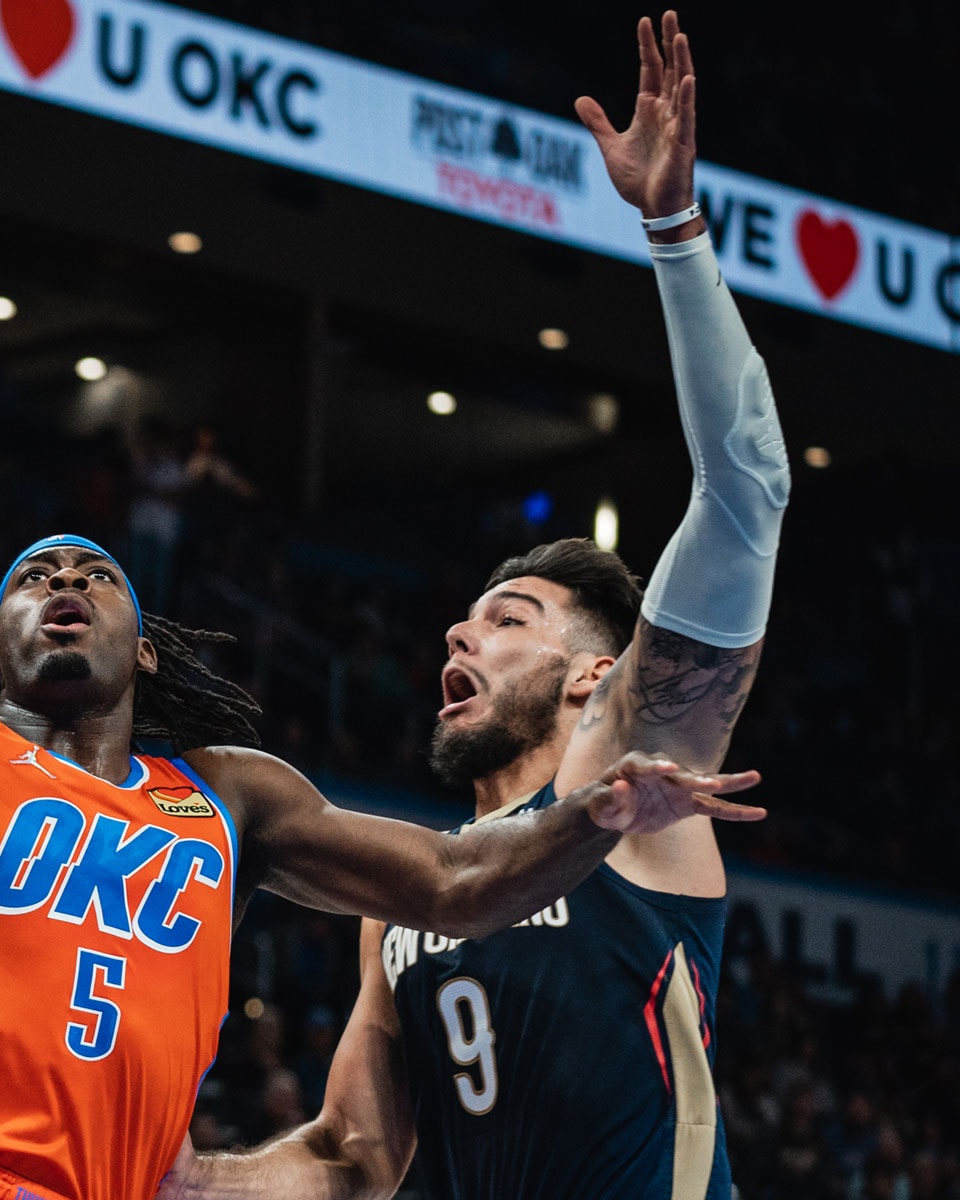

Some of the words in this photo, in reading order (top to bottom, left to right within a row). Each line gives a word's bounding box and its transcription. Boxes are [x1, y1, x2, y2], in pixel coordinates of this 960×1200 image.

[96, 11, 146, 89] U
[170, 38, 320, 139] OKC
[875, 237, 915, 308] U
[64, 947, 127, 1062] 5
[436, 976, 499, 1117] 9
